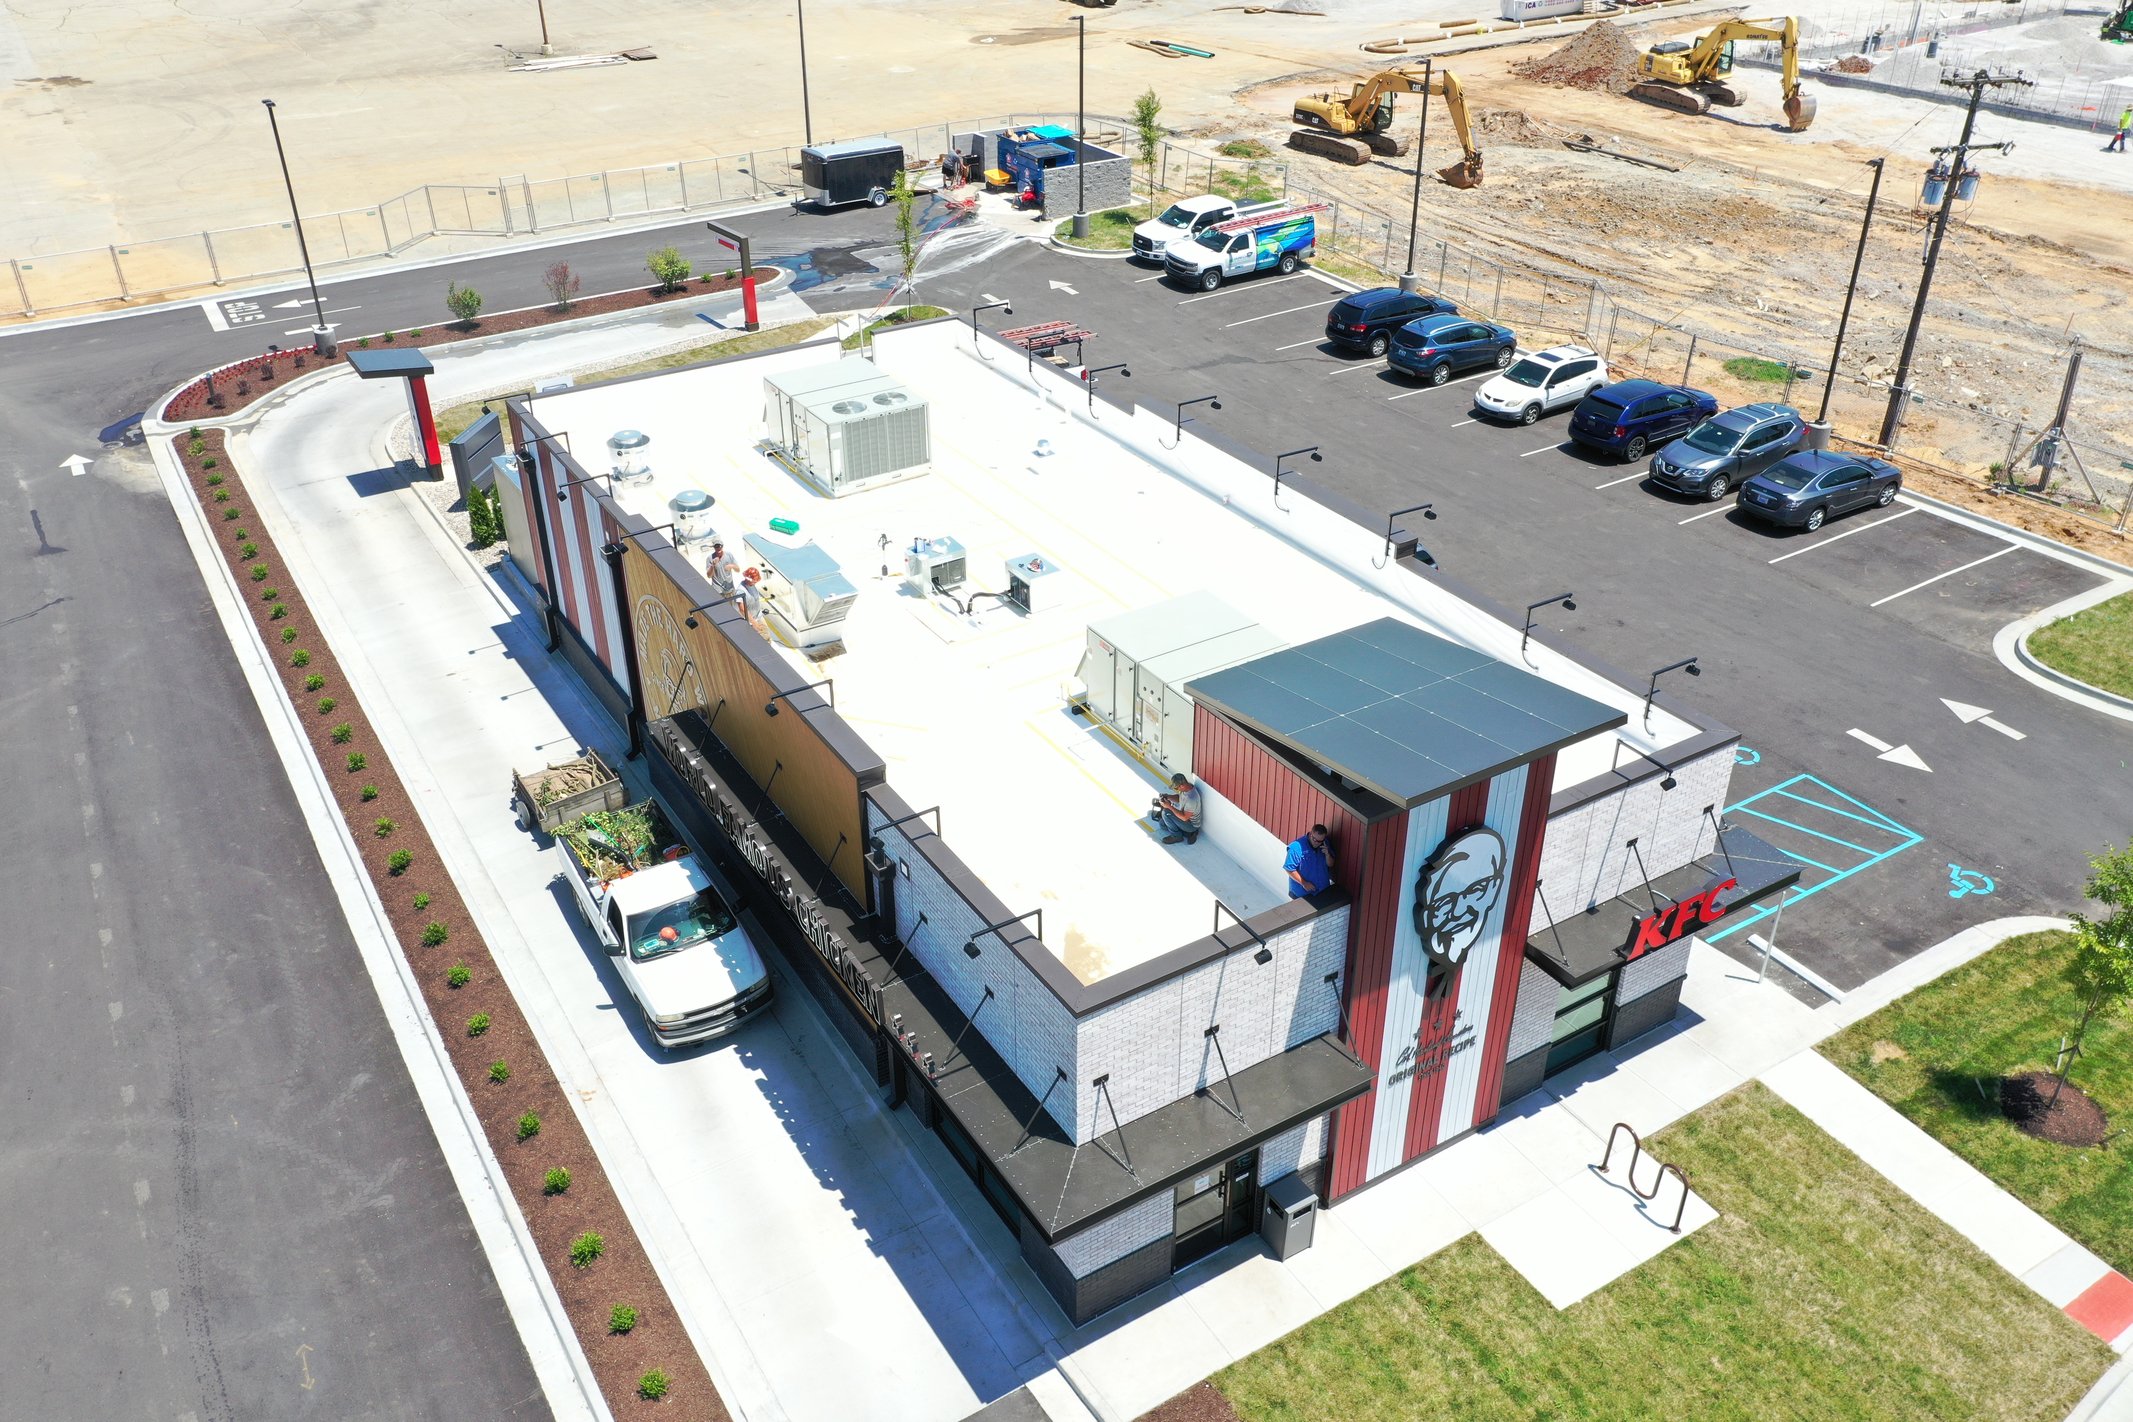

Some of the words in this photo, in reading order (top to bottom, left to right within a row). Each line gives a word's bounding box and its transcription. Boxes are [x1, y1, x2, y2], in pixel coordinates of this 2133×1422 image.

[660, 724, 719, 818] WORLD
[717, 794, 794, 911] FAMOUS
[795, 893, 886, 1026] CHICKEN
[1627, 877, 1737, 961] KFC
[1388, 1055, 1440, 1087] ORIGINAL
[1440, 1035, 1477, 1062] RECIPE
